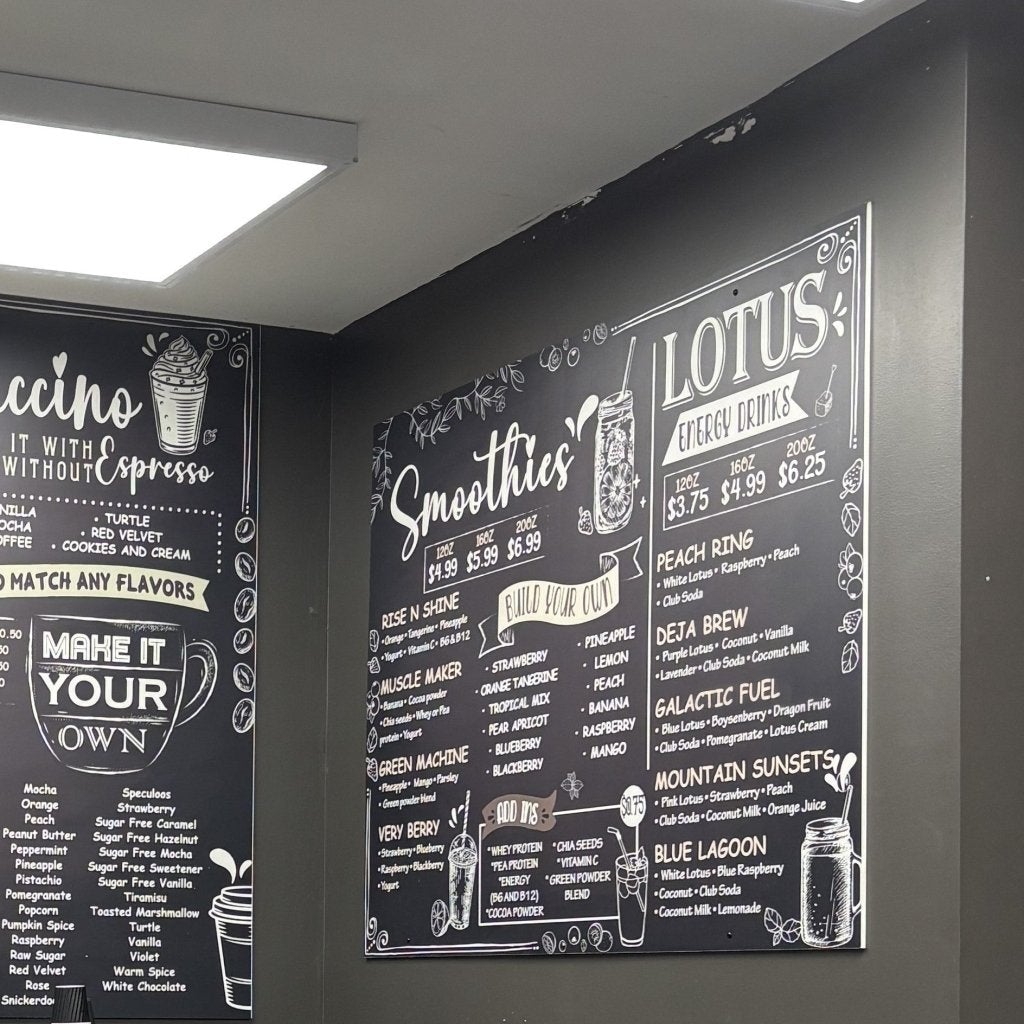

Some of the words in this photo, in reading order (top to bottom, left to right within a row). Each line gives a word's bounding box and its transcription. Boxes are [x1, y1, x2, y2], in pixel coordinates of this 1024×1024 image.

[662, 270, 827, 409] LOTUS
[679, 406, 731, 452] ENERGY
[738, 386, 790, 432] DRINKS
[12, 433, 28, 453] IT
[43, 436, 92, 459] WITH
[2, 456, 92, 482] WITHOUT
[95, 435, 214, 494] Espresso
[779, 450, 825, 488] $6.25
[389, 422, 574, 561] Smoothies
[722, 471, 765, 505] $4.99
[668, 488, 708, 521] $3.75
[105, 513, 150, 527] TURTLE
[62, 540, 116, 554] COOKIES
[122, 545, 146, 557] AND
[152, 547, 190, 560] CREAM
[467, 545, 498, 573] $5.99
[508, 531, 541, 560] $6.99
[657, 542, 705, 572] PEACH
[712, 529, 754, 558] RING
[429, 558, 457, 584] $4.99
[11, 572, 71, 590] MATCH
[77, 572, 110, 590] ANY
[116, 574, 194, 600] FLAVORS
[506, 585, 540, 622] BUILD
[545, 585, 576, 617] YOUR
[583, 578, 612, 615] OWN
[663, 594, 680, 607] Club
[682, 588, 703, 602] Soda
[382, 608, 406, 629] RISE
[409, 604, 421, 624] N
[423, 592, 459, 618] SHINE
[657, 620, 696, 645] DEJA
[704, 607, 748, 635] BREW
[42, 630, 132, 660] MAKE
[141, 638, 166, 665] IT
[39, 674, 167, 711] YOUR
[381, 670, 421, 695] MUSCLE
[425, 662, 462, 684] MAKER
[589, 696, 629, 714] BANANA
[656, 686, 733, 718] GALACTIC
[740, 678, 780, 704] FUEL
[59, 725, 147, 753] OWN
[655, 760, 745, 790] MOUNTAIN
[752, 749, 834, 777] SUNSETS
[24, 784, 56, 794] Mocha
[496, 802, 517, 824] ADD
[11, 844, 68, 857] Peppermint
[655, 841, 692, 863] BLUE
[698, 836, 766, 860] LAGOON
[124, 892, 166, 902] Tiramisu
[565, 889, 590, 900] BLEND
[90, 906, 131, 916] Toasted
[136, 908, 199, 918] Marshmallow
[102, 981, 133, 991] White
[138, 982, 186, 991] Chocolate
